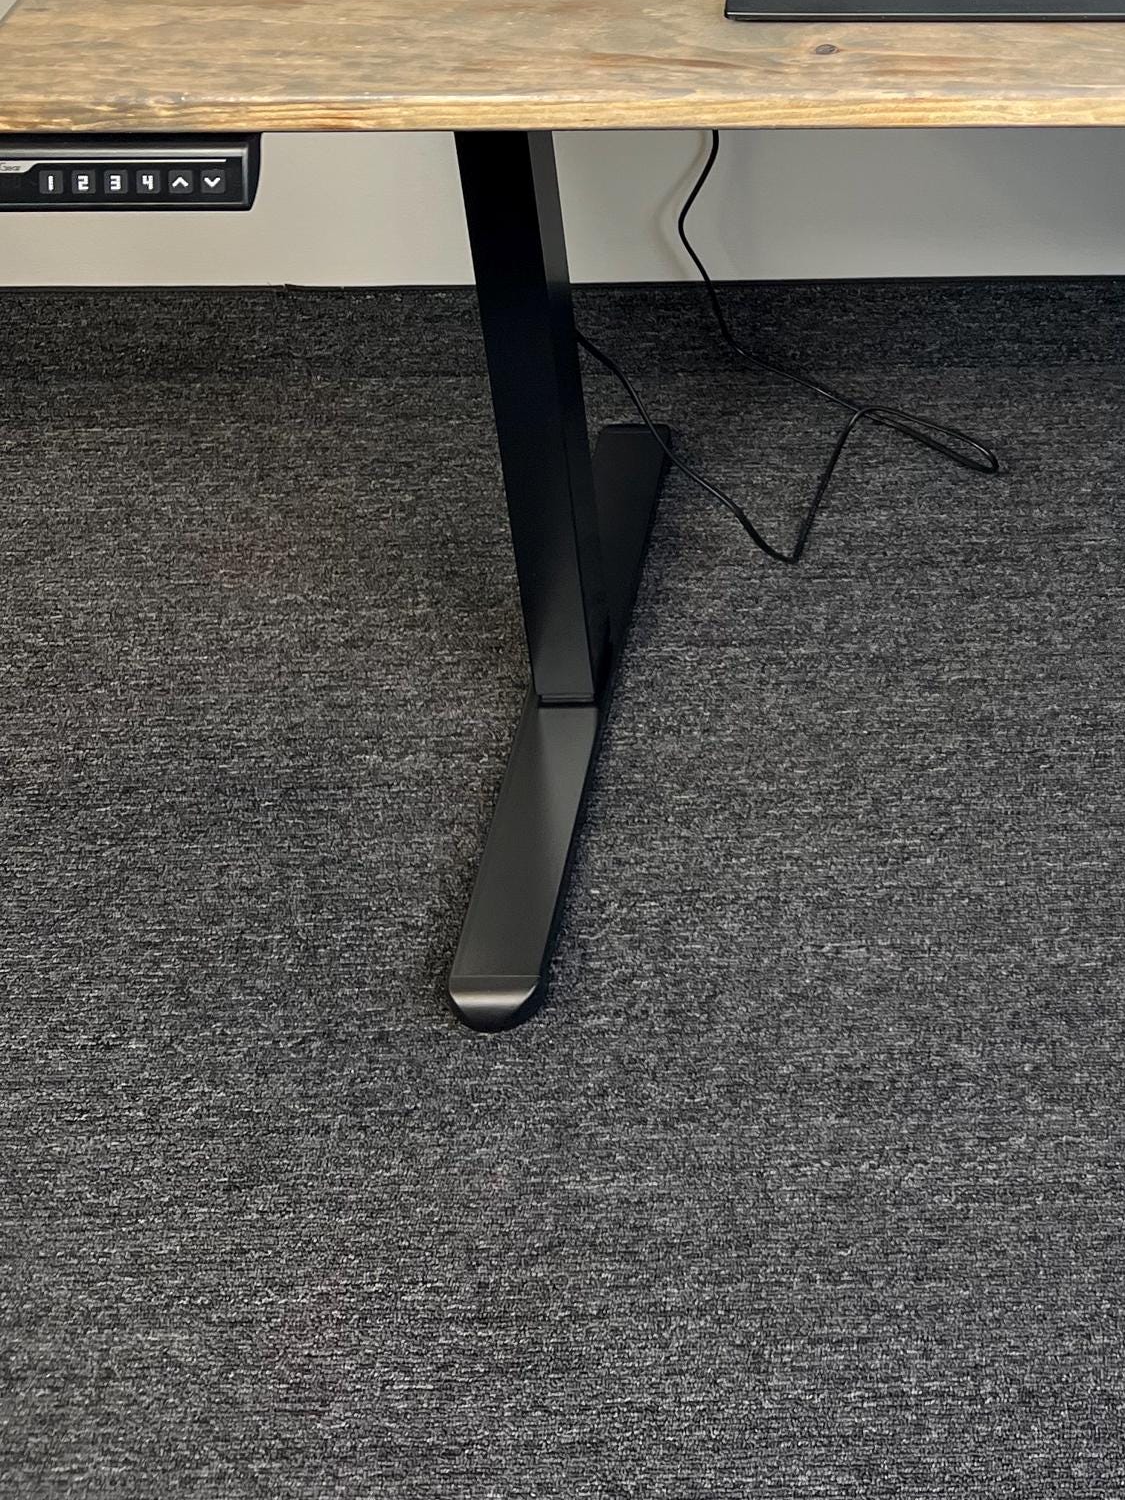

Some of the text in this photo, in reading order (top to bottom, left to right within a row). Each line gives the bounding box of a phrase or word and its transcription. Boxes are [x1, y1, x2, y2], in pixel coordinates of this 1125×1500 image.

[47, 175, 153, 191] 1 2 3 4
